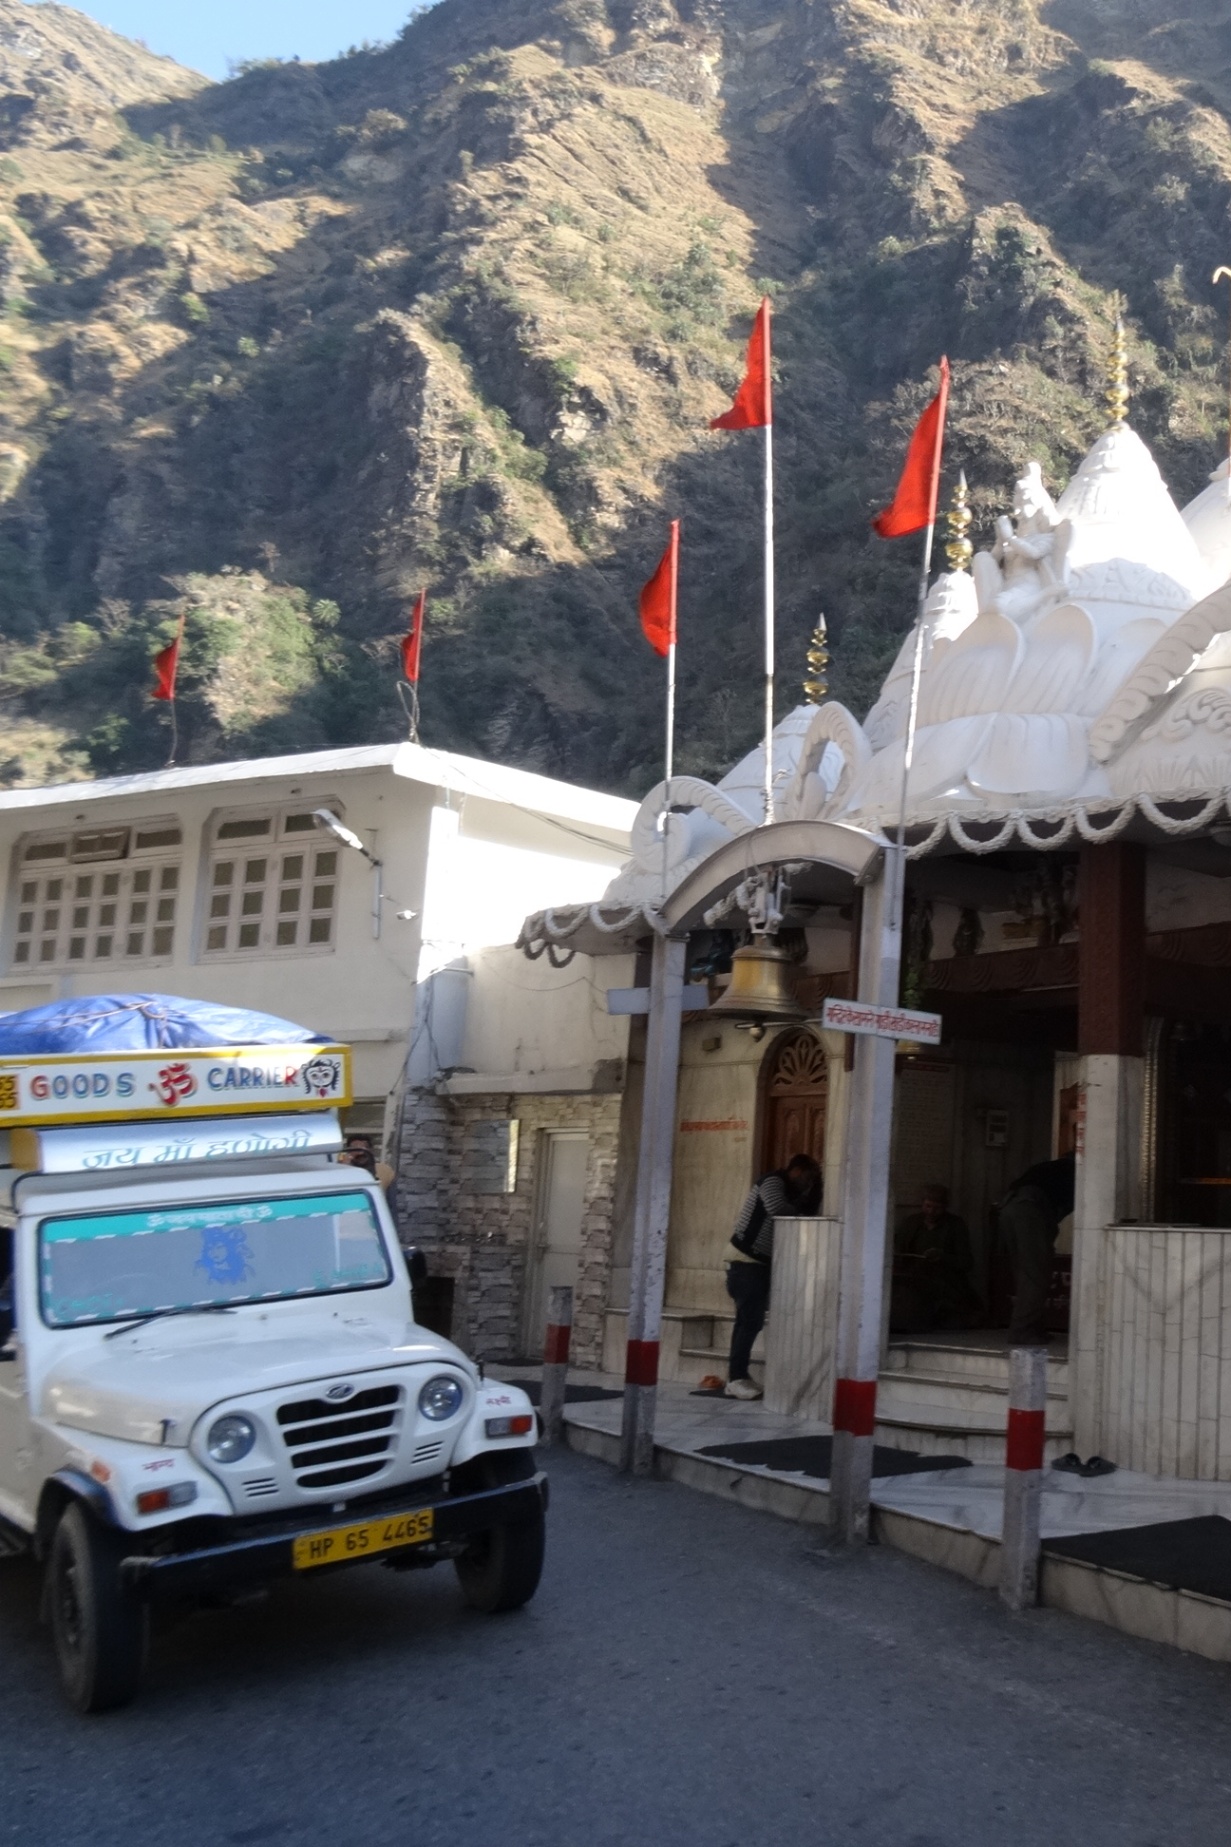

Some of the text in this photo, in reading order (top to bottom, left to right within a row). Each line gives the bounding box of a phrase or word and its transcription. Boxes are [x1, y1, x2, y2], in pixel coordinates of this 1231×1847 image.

[30, 1073, 136, 1100] GOODS
[207, 1066, 300, 1091] CARRIER
[82, 1146, 145, 1169] जय
[309, 1537, 334, 1559] HP
[346, 1529, 369, 1551] 65
[383, 1515, 430, 1542] 4465
